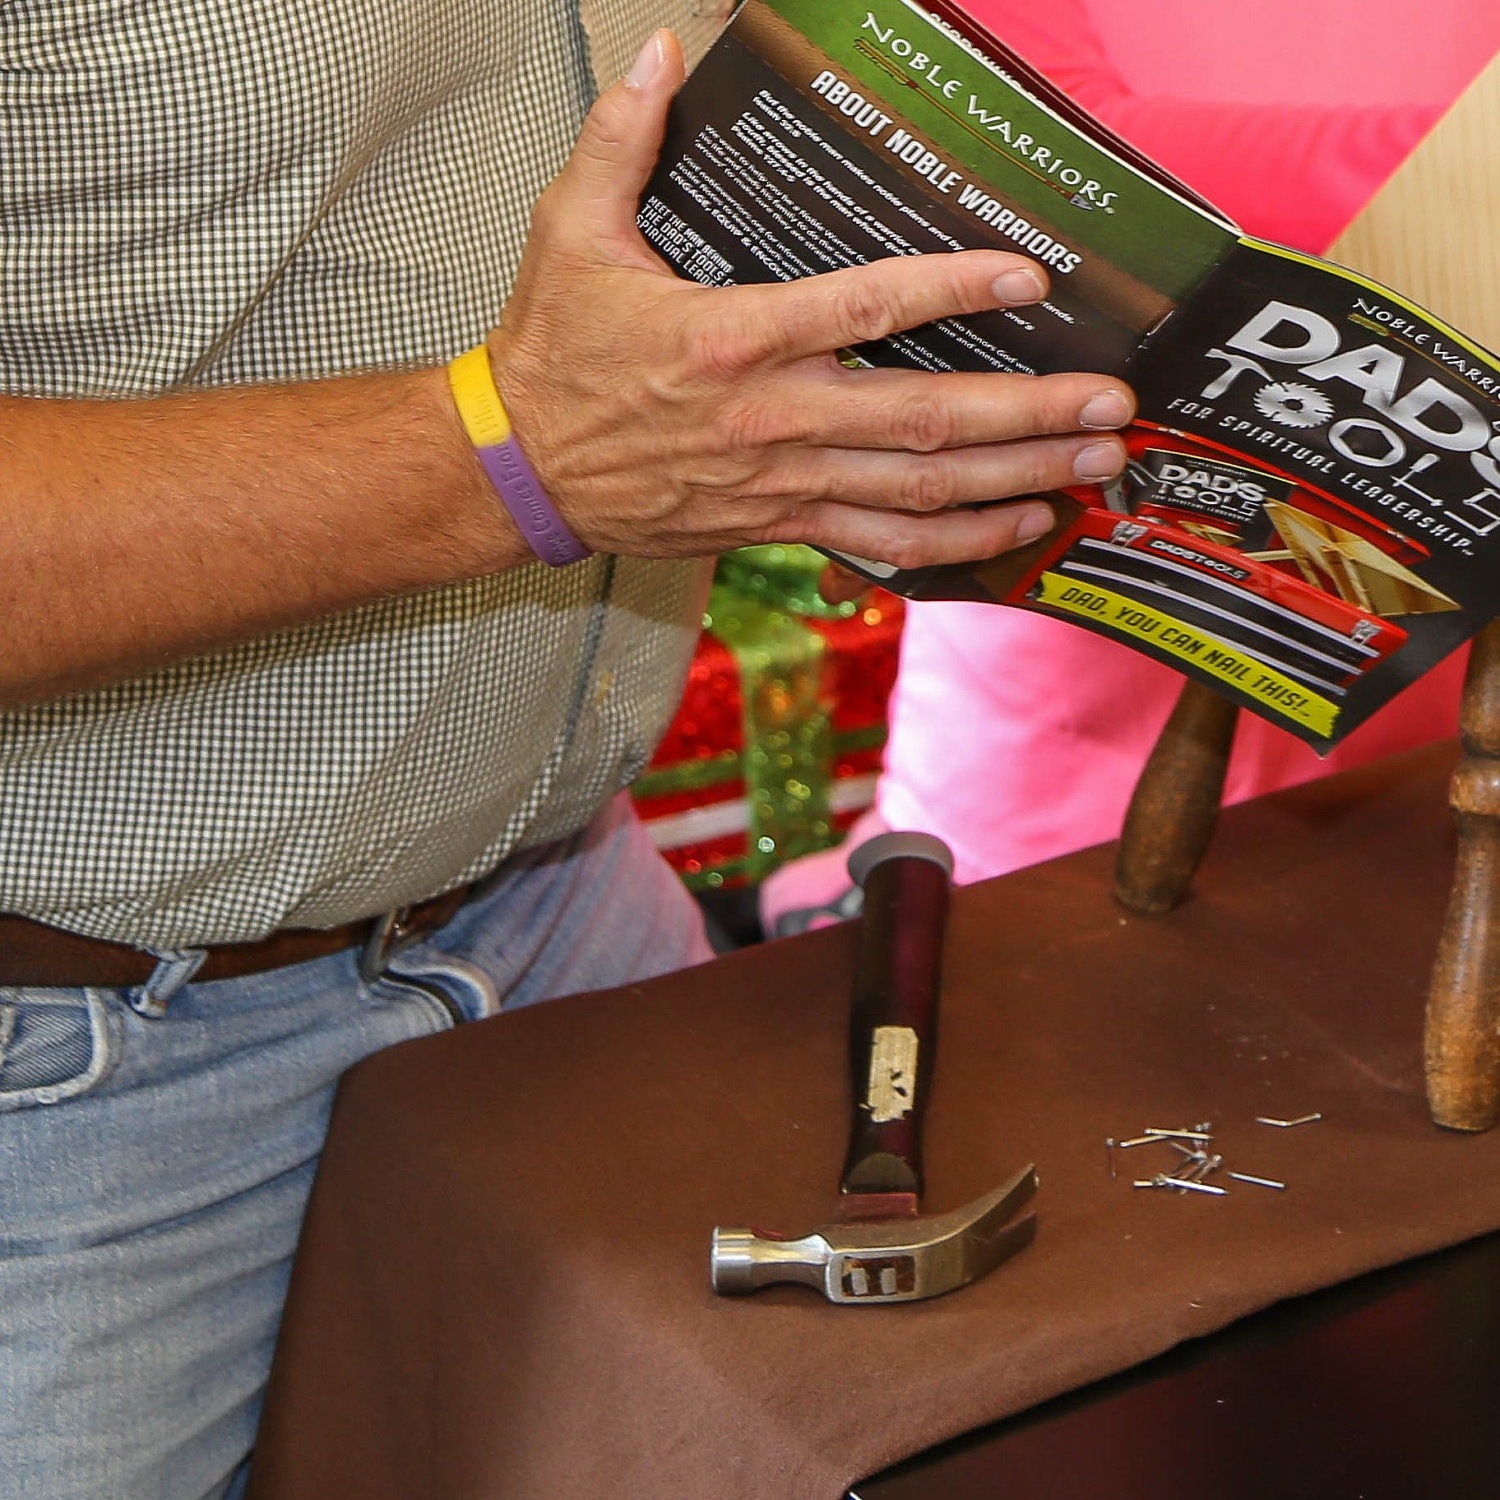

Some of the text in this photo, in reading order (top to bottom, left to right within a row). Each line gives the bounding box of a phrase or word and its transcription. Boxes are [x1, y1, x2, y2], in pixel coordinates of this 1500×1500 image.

[730, 124, 763, 155] Psalms
[752, 95, 781, 121] Isaiah
[861, 12, 962, 98] NOBLE
[967, 94, 1117, 208] WARRIORS
[668, 170, 711, 211] ENGAGE,
[710, 208, 743, 236] EQUIP
[749, 244, 792, 282] ENCOUR
[675, 161, 700, 184] Noble
[698, 183, 723, 206] Notes
[721, 204, 732, 214] to
[730, 212, 752, 232] keep
[758, 238, 782, 261] touch
[781, 259, 799, 276] with
[723, 167, 735, 178] to
[732, 176, 756, 197] make
[754, 196, 773, 213] sure
[771, 211, 792, 230] they
[789, 229, 806, 241] are
[804, 240, 837, 269] straight,
[735, 118, 766, 146] youth,
[765, 144, 806, 177] blessed
[801, 175, 815, 186] is
[812, 184, 832, 200] the
[828, 198, 854, 217] man
[851, 216, 887, 242] whose
[741, 111, 765, 130] Like
[761, 130, 797, 159] arrows
[794, 157, 808, 168] in
[805, 166, 825, 182] the
[822, 180, 855, 206] hands
[852, 205, 869, 218] of
[872, 220, 911, 247] warrior
[1003, 311, 1034, 330] one's
[758, 89, 1074, 324] But the noble man makes noble plans and by tands.
[811, 70, 1081, 273] ABOUT NOBLE WARRIORS
[635, 213, 684, 263] SPIRITUAL
[640, 202, 725, 281] THE DAD'S TOOLS
[647, 195, 733, 273] MEET THE MAN BEHIND
[682, 153, 701, 172] Visit
[763, 230, 779, 242] for
[914, 345, 933, 358] also
[697, 131, 712, 145] his
[710, 142, 725, 156] life
[723, 156, 742, 171] and
[738, 168, 761, 190] leads
[759, 187, 773, 201] his
[771, 198, 798, 222] family
[795, 220, 807, 231] to
[805, 229, 820, 240] do
[817, 238, 834, 251] the
[955, 336, 975, 349] and
[973, 347, 1004, 368] energy
[704, 123, 720, 138] We
[718, 137, 740, 157] want
[738, 155, 749, 166] to
[746, 163, 768, 182] help
[764, 180, 783, 196] you
[780, 193, 794, 205] be
[797, 209, 825, 231] Noble
[823, 229, 857, 255] Warrior
[964, 329, 996, 351] honors
[995, 349, 1016, 363] God
[1014, 361, 1035, 375] with
[1352, 297, 1430, 344] NOBLE
[1166, 397, 1471, 552] FOR SPIRITUAL LEADERSHIP
[1058, 586, 1309, 710] DAD, YOU CAN NAIL THIS!
